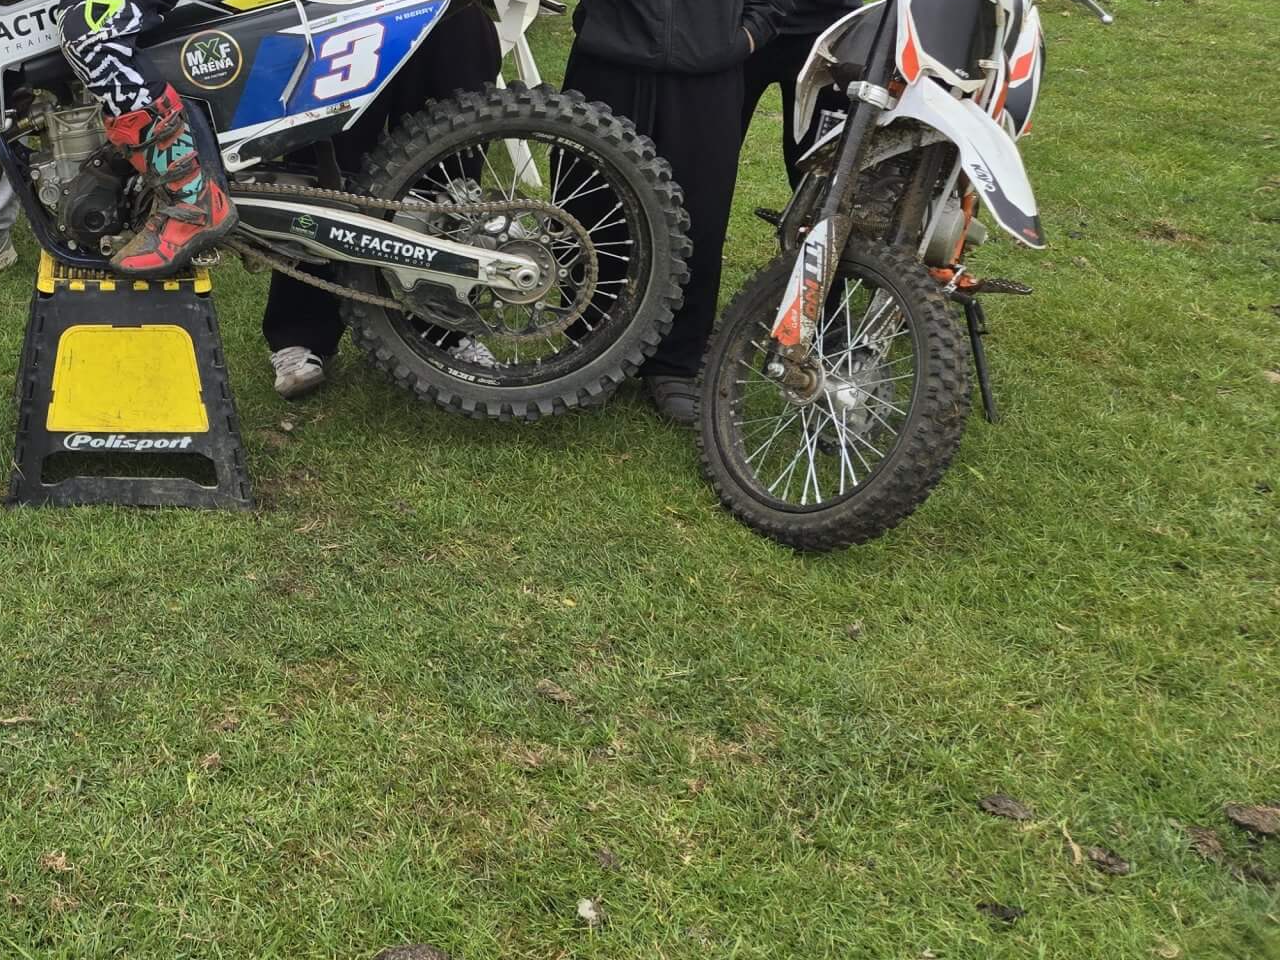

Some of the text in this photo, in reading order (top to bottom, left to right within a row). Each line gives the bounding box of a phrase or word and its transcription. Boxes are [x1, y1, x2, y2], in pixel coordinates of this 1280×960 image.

[404, 6, 434, 19] BERRY
[4, 34, 52, 53] TRAIN
[186, 38, 231, 67] MXF
[191, 57, 234, 77] ARENA
[313, 22, 385, 100] 3
[329, 227, 357, 244] MX
[360, 234, 438, 262] FACTORY
[63, 432, 193, 451] Polisport
